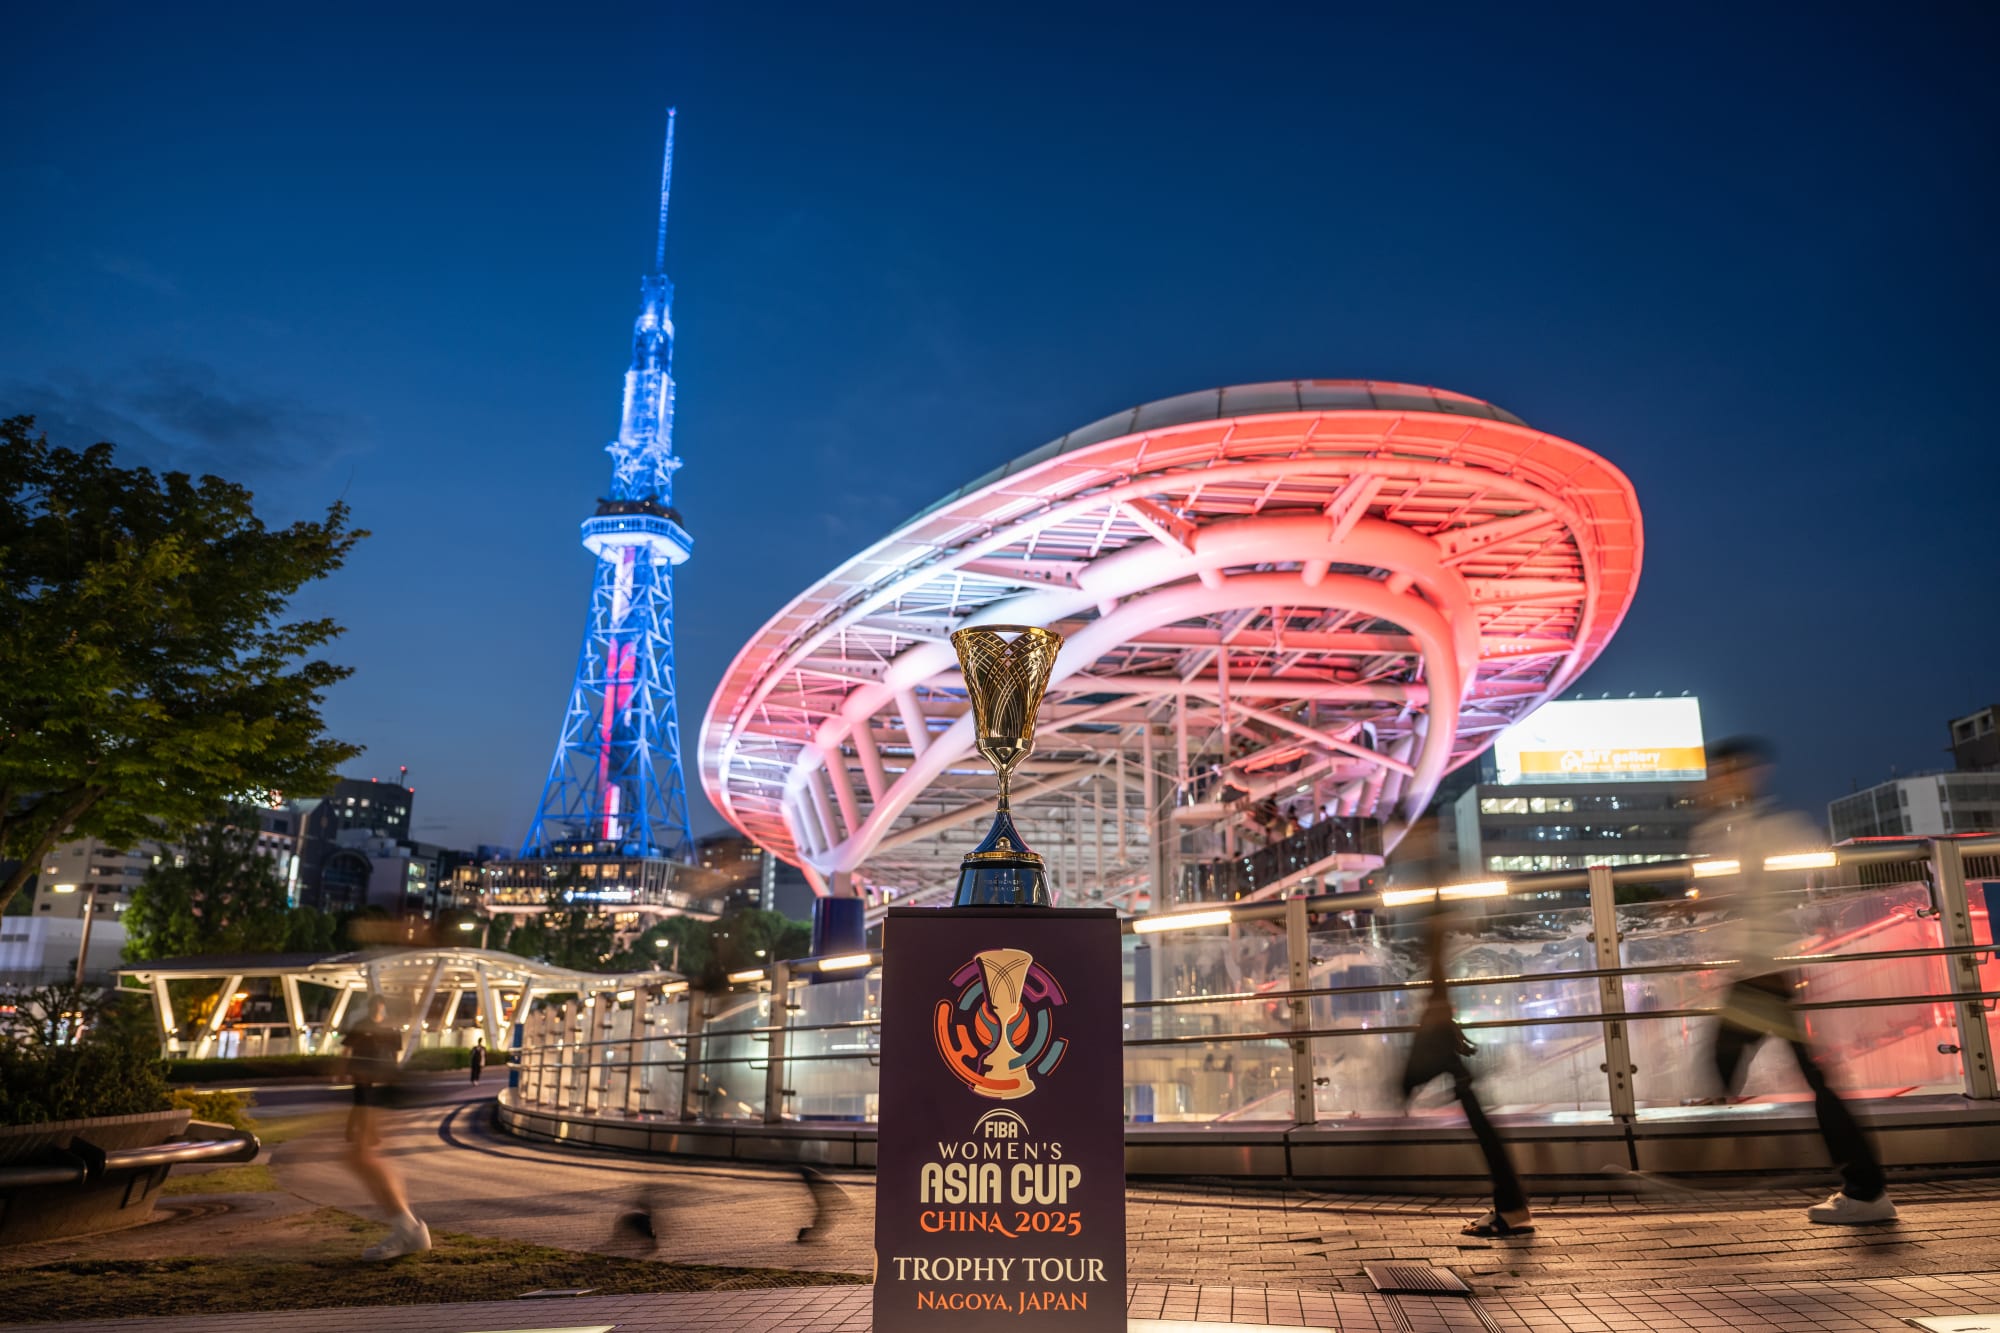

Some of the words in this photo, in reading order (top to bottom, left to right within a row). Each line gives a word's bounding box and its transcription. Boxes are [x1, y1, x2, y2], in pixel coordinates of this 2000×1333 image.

[985, 1121, 1018, 1138] FIBA
[938, 1142, 1062, 1160] WOMEN'S
[920, 1162, 1001, 1205] ASIA
[1010, 1162, 1082, 1205] CUP
[920, 1210, 1019, 1238] CHINA
[1015, 1211, 1082, 1237] 2025
[893, 1257, 1016, 1282] TROPHY
[1021, 1257, 1108, 1282] TOUR
[917, 1291, 1013, 1313] NAGOYA,
[1018, 1291, 1088, 1315] JAPAN
